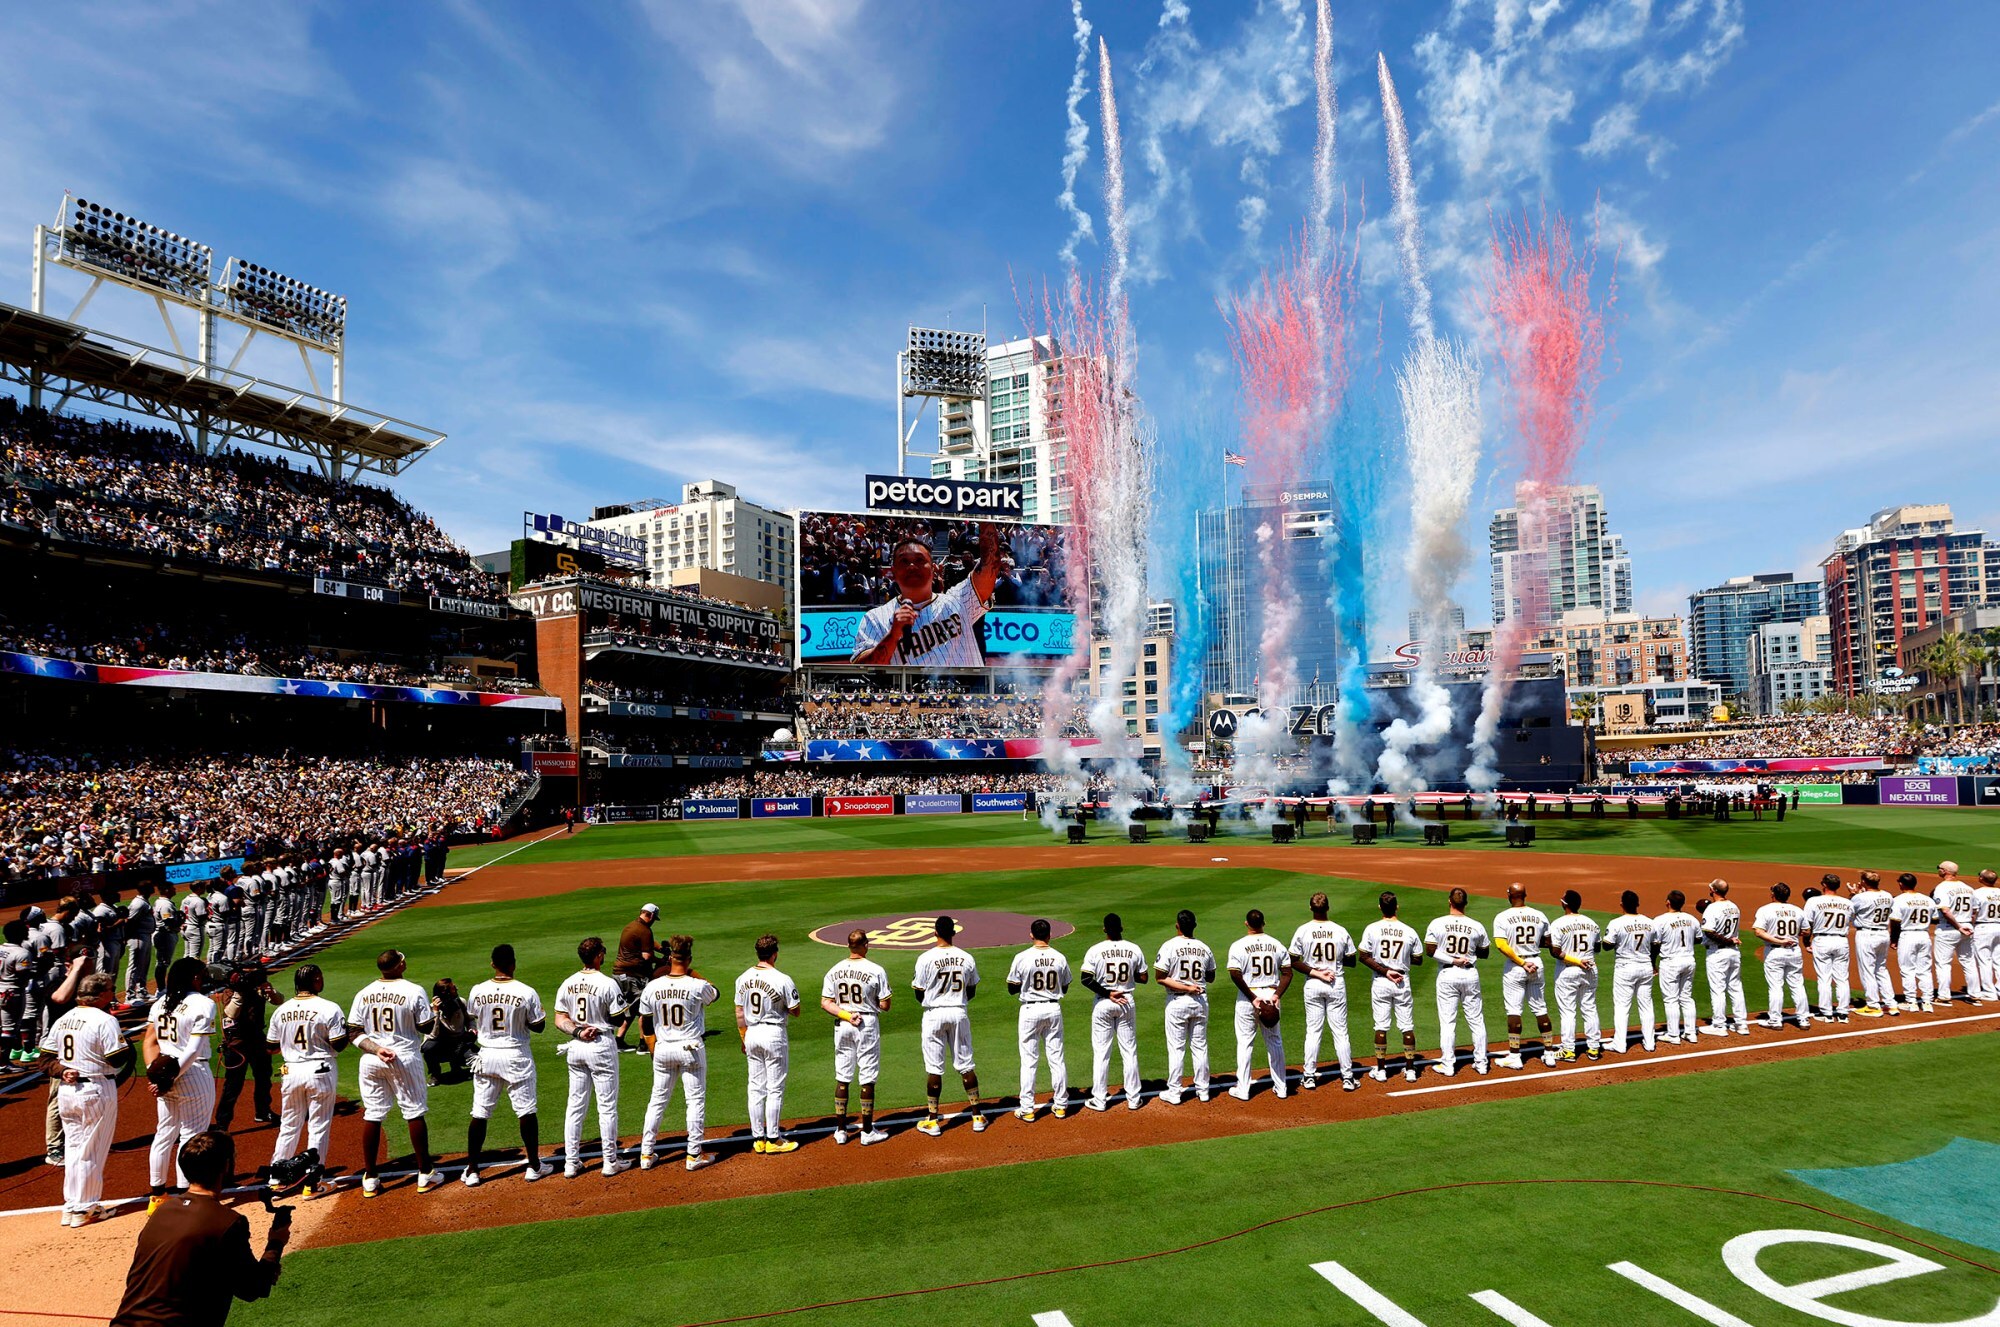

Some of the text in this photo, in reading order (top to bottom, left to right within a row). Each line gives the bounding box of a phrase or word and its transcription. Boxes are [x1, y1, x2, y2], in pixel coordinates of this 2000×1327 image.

[869, 479, 1020, 511] petco park
[1293, 492, 1328, 500] SEMPRA
[567, 521, 646, 551] QuidelOrtho
[363, 587, 383, 601] 1:04
[552, 591, 576, 612] CO.
[440, 598, 499, 617] CUTWATER
[580, 589, 652, 617] WESTERN
[660, 603, 705, 626] METAL
[708, 613, 754, 634] SUPPLY
[760, 622, 778, 638] CO.
[899, 613, 961, 662] PADRES
[984, 618, 1039, 641] etco
[1868, 678, 1919, 687] Gallagher
[1875, 685, 1911, 694] Square
[627, 703, 657, 716] ORIS
[1619, 703, 1630, 715] 19
[976, 799, 1017, 807] Southwest
[1803, 791, 1823, 800] Diego
[699, 805, 737, 814] Palomar
[844, 803, 889, 812] Snapdragon
[918, 800, 959, 808] QuidelOrtho
[662, 808, 679, 818] 342
[1817, 903, 1850, 911] HAMMOCK
[1955, 896, 1970, 912] 85
[1507, 915, 1540, 925] HEYWARD
[1824, 912, 1845, 928] 70
[1873, 908, 1890, 923] 33
[1909, 908, 1929, 924] 46
[1381, 928, 1403, 937] JACOB
[1445, 924, 1472, 935] SHEETS
[1560, 924, 1600, 935] MALDONADO
[1624, 923, 1652, 933] IGLESIAS
[1670, 920, 1692, 929] MATSUI
[1723, 918, 1739, 935] 87
[1777, 920, 1797, 936] 80
[1312, 931, 1333, 939] ADAM
[1515, 926, 1535, 944] 22
[1634, 934, 1644, 951] 7
[1680, 930, 1686, 948] 1
[1244, 944, 1277, 954] MOREJON
[1380, 940, 1403, 960] 37
[1446, 935, 1469, 955] 30
[1573, 934, 1589, 953] 15
[1101, 949, 1133, 960] PERALTA
[1176, 947, 1206, 958] ESTRADA
[1312, 942, 1335, 962] 40
[934, 957, 965, 969] SUAREZ
[1034, 958, 1055, 968] CRUZ
[1179, 960, 1202, 980] 56
[1252, 956, 1273, 977] 50
[831, 970, 872, 984] LOCKRIDGE
[1033, 970, 1058, 991] 60
[1106, 962, 1129, 983] 58
[567, 983, 599, 997] MERRILL
[937, 970, 963, 994] 75
[362, 993, 406, 1006] MACHADO
[655, 989, 691, 1001] GURRIEL
[739, 979, 781, 1004] RONENWORTH
[838, 983, 862, 1004] 28
[475, 993, 523, 1008] BOGAERTS
[750, 992, 761, 1016] 9
[280, 1010, 318, 1024] ARRAEZ
[576, 997, 587, 1022] 3
[661, 1003, 684, 1027] 10
[58, 1019, 87, 1032] SHILDT
[371, 1007, 394, 1032] 13
[491, 1007, 505, 1031] 2
[158, 1014, 177, 1043] 23
[293, 1024, 307, 1050] 4
[63, 1034, 74, 1061] 8
